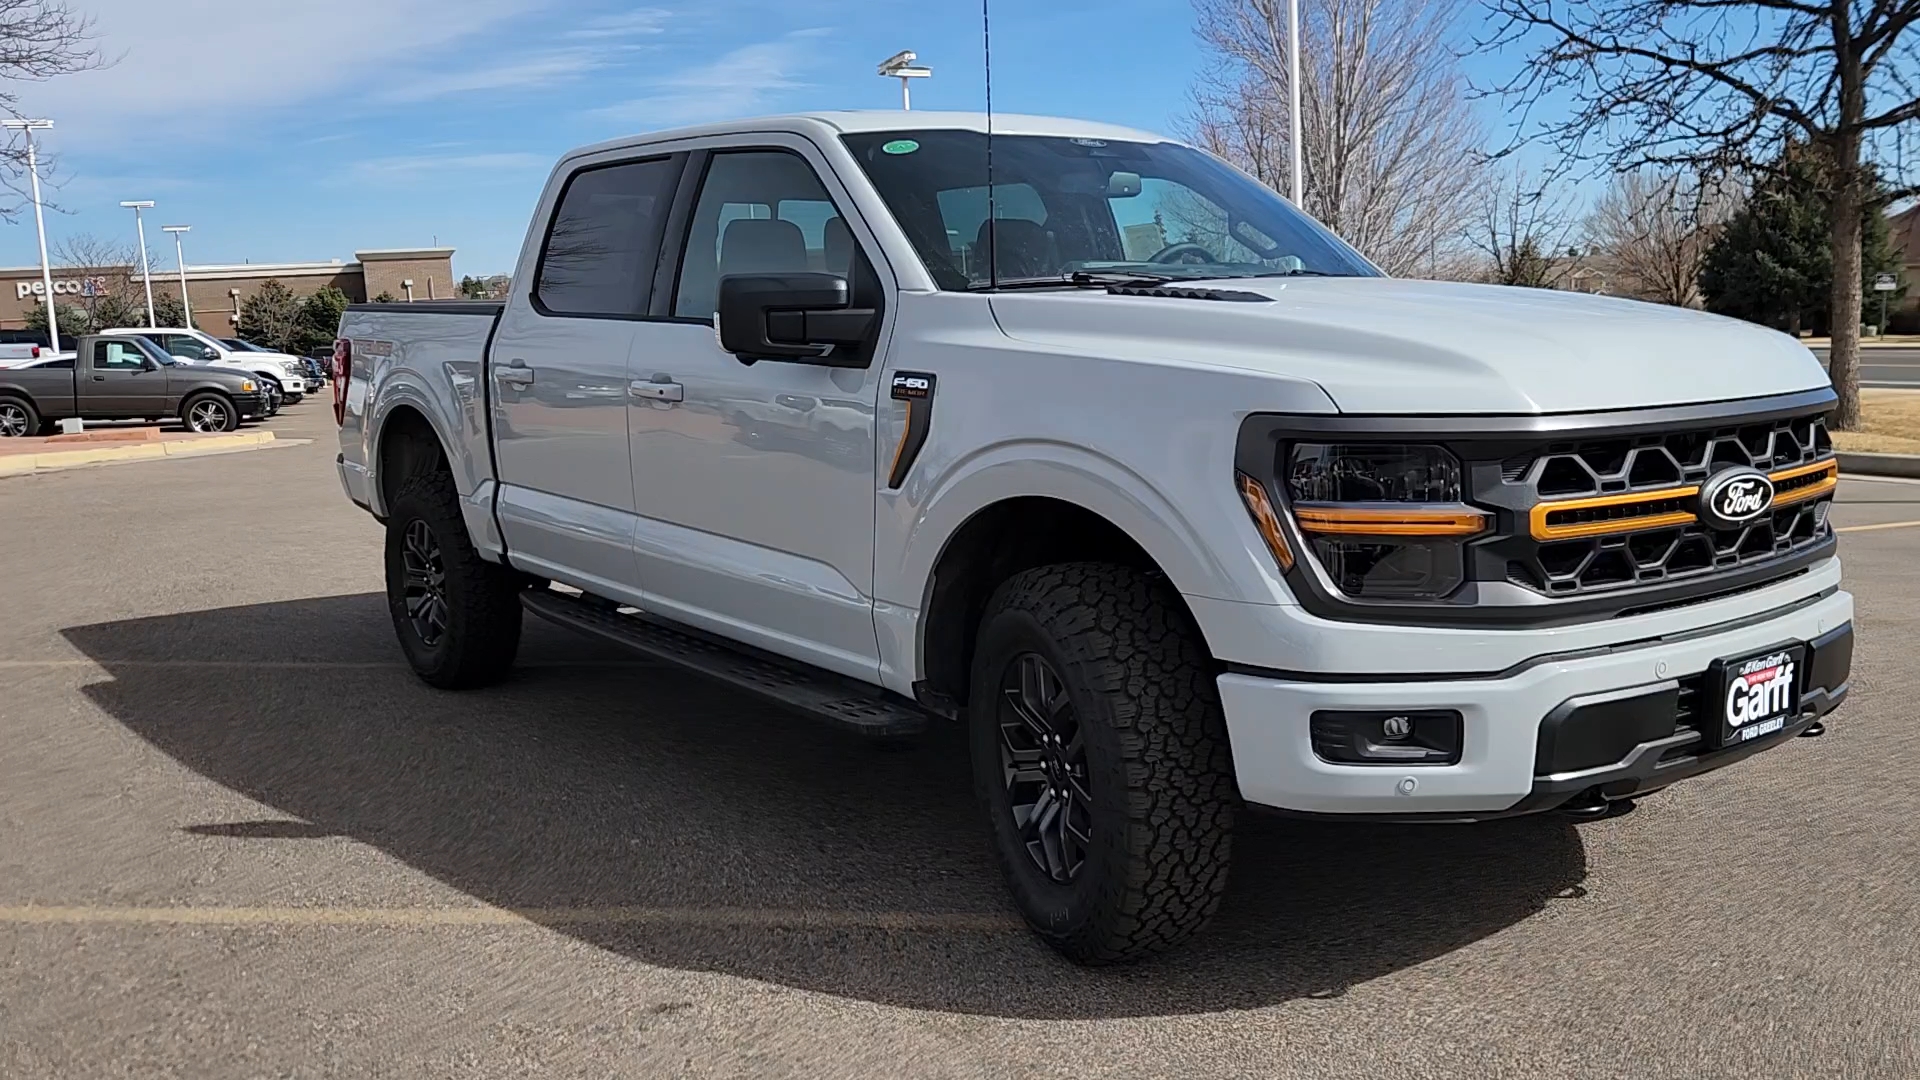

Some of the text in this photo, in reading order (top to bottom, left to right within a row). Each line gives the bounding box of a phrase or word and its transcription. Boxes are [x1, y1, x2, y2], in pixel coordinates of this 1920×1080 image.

[893, 377, 929, 389] F-150
[1723, 481, 1764, 515] Ford
[1726, 662, 1794, 728] Garff
